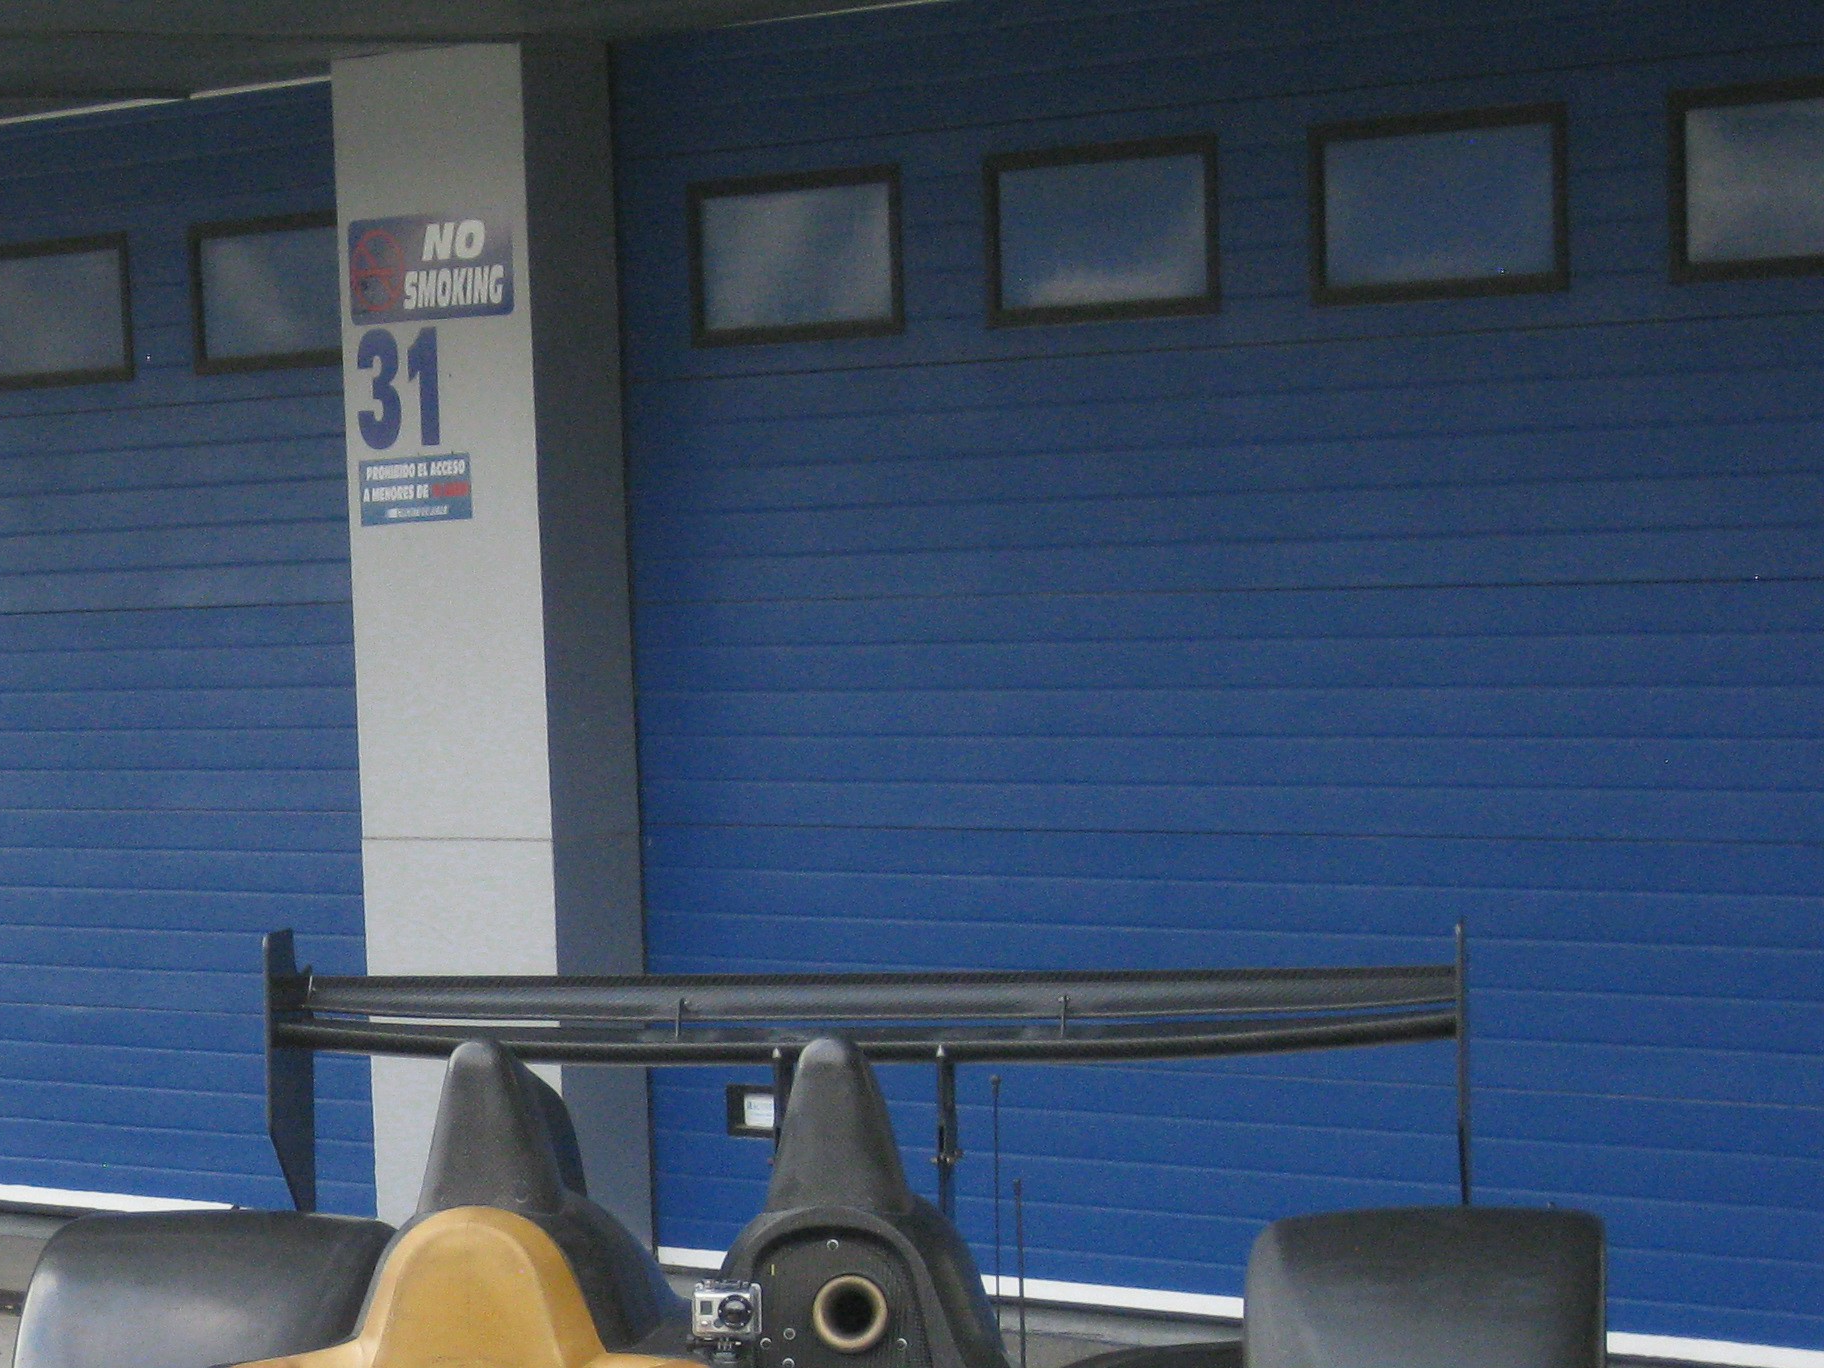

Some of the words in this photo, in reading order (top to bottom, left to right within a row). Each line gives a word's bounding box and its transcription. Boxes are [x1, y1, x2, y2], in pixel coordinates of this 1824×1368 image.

[421, 219, 486, 262] NO
[403, 264, 505, 310] SMOKING
[357, 326, 440, 450] 31
[417, 462, 429, 477] EL
[430, 459, 465, 477] ACCESO
[363, 487, 370, 502] A
[372, 484, 414, 502] MENORES
[416, 484, 430, 499] DE
